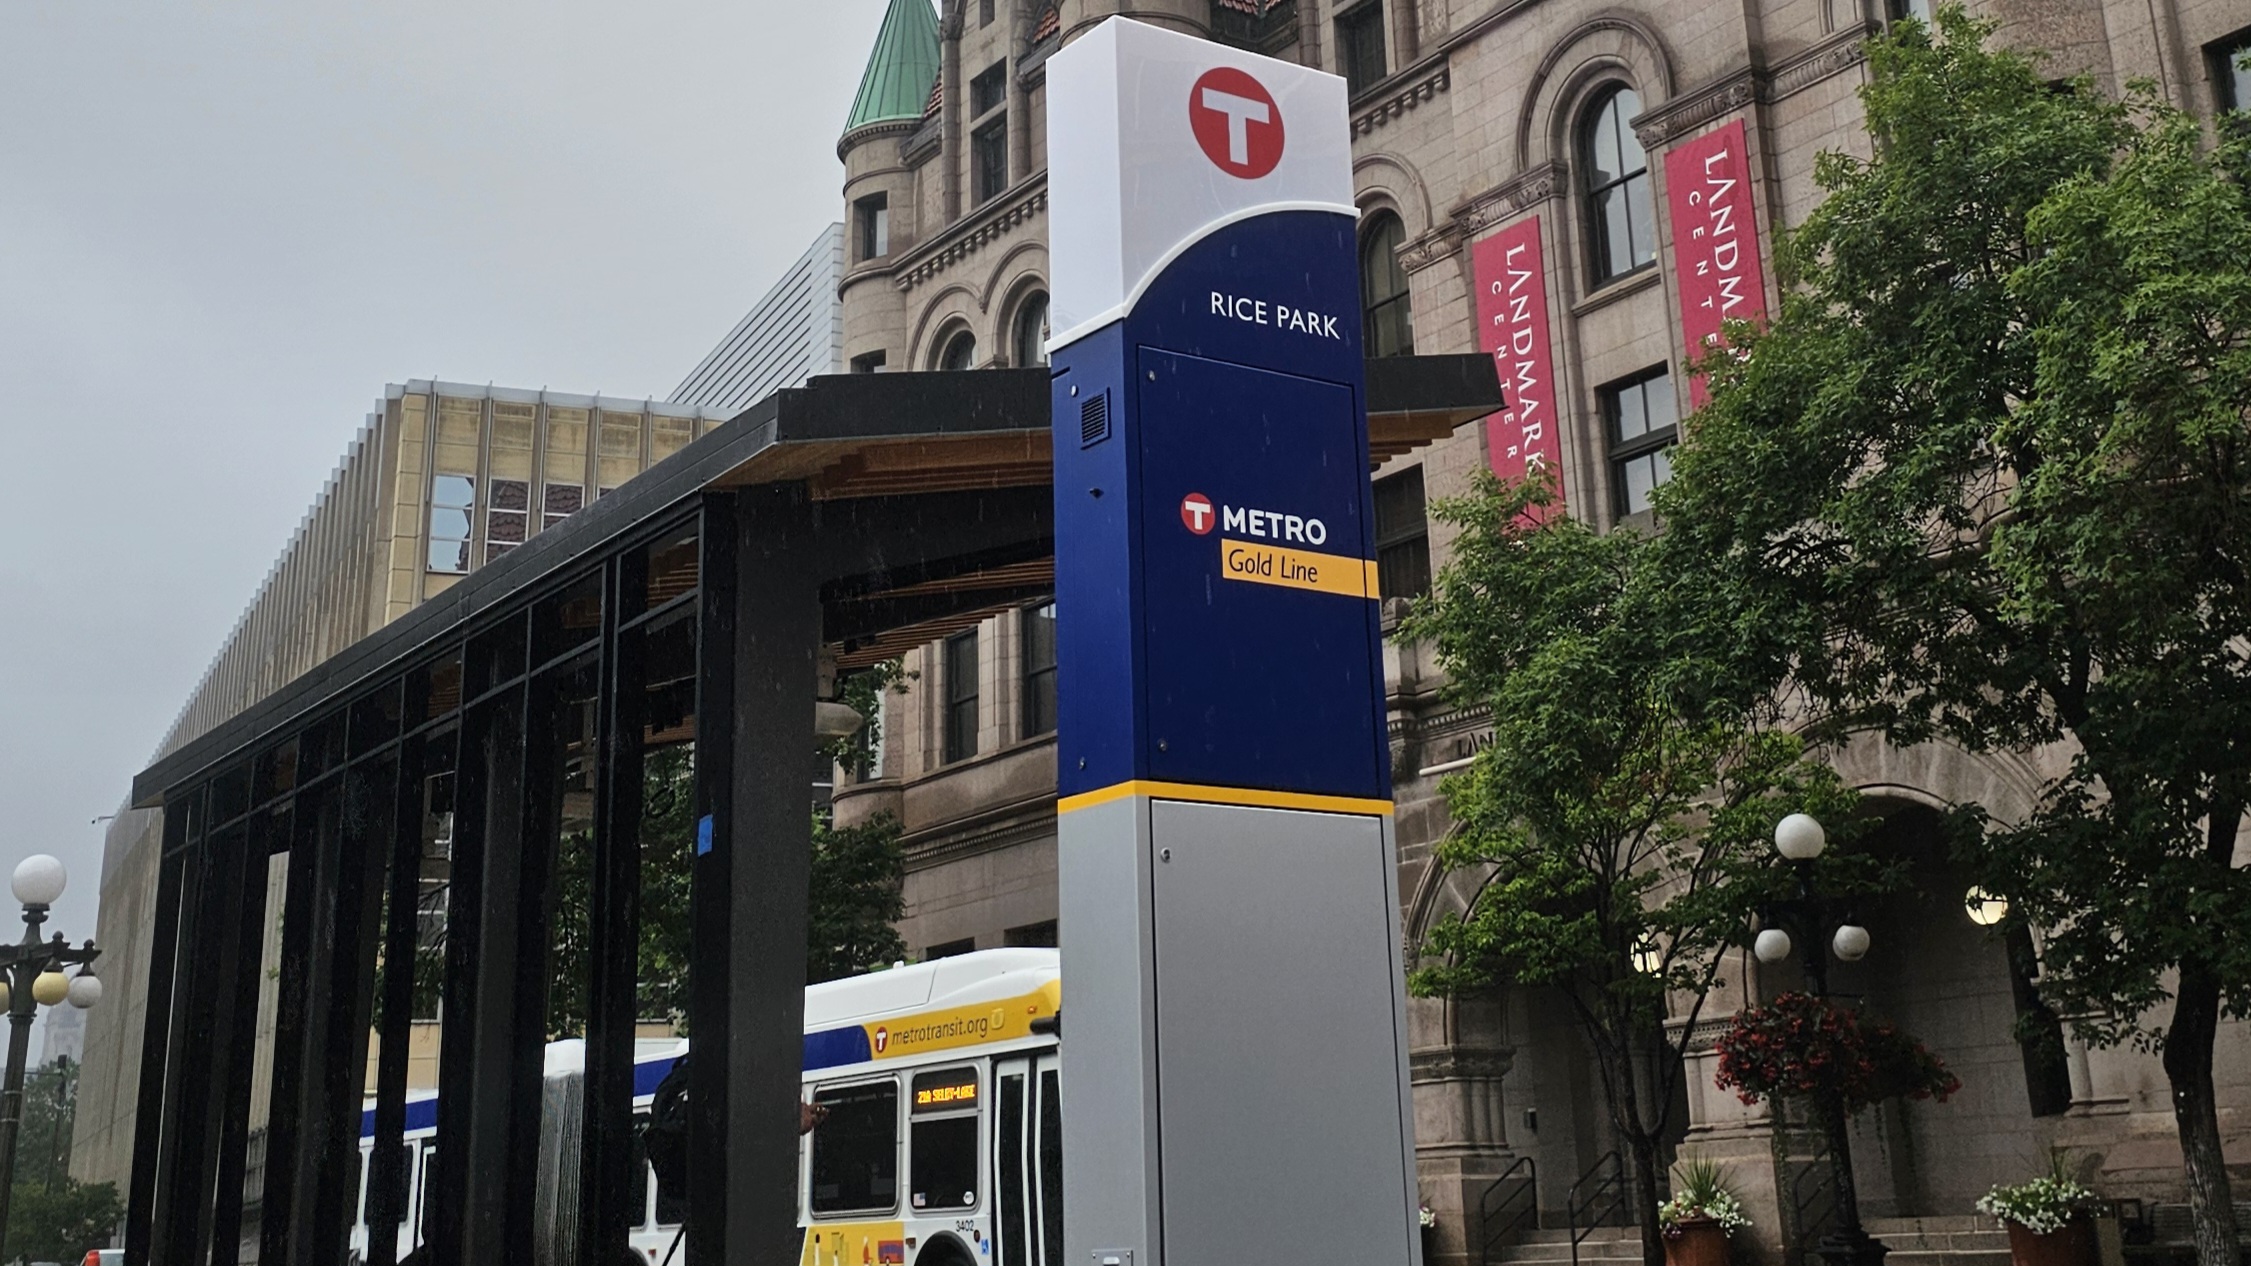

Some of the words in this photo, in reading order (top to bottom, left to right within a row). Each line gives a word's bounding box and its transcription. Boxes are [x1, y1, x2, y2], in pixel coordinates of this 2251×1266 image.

[1201, 86, 1270, 166] T
[1211, 290, 1268, 326] RICE
[1277, 304, 1341, 341] PARK
[1491, 280, 1518, 459] CENTER
[1184, 500, 1212, 531] T
[1222, 504, 1327, 546] METRO
[1228, 548, 1273, 577] Gold
[1281, 555, 1318, 583] Line
[876, 1030, 887, 1052] T
[891, 1016, 988, 1046] metrotransit.org
[955, 1219, 975, 1233] 3402
